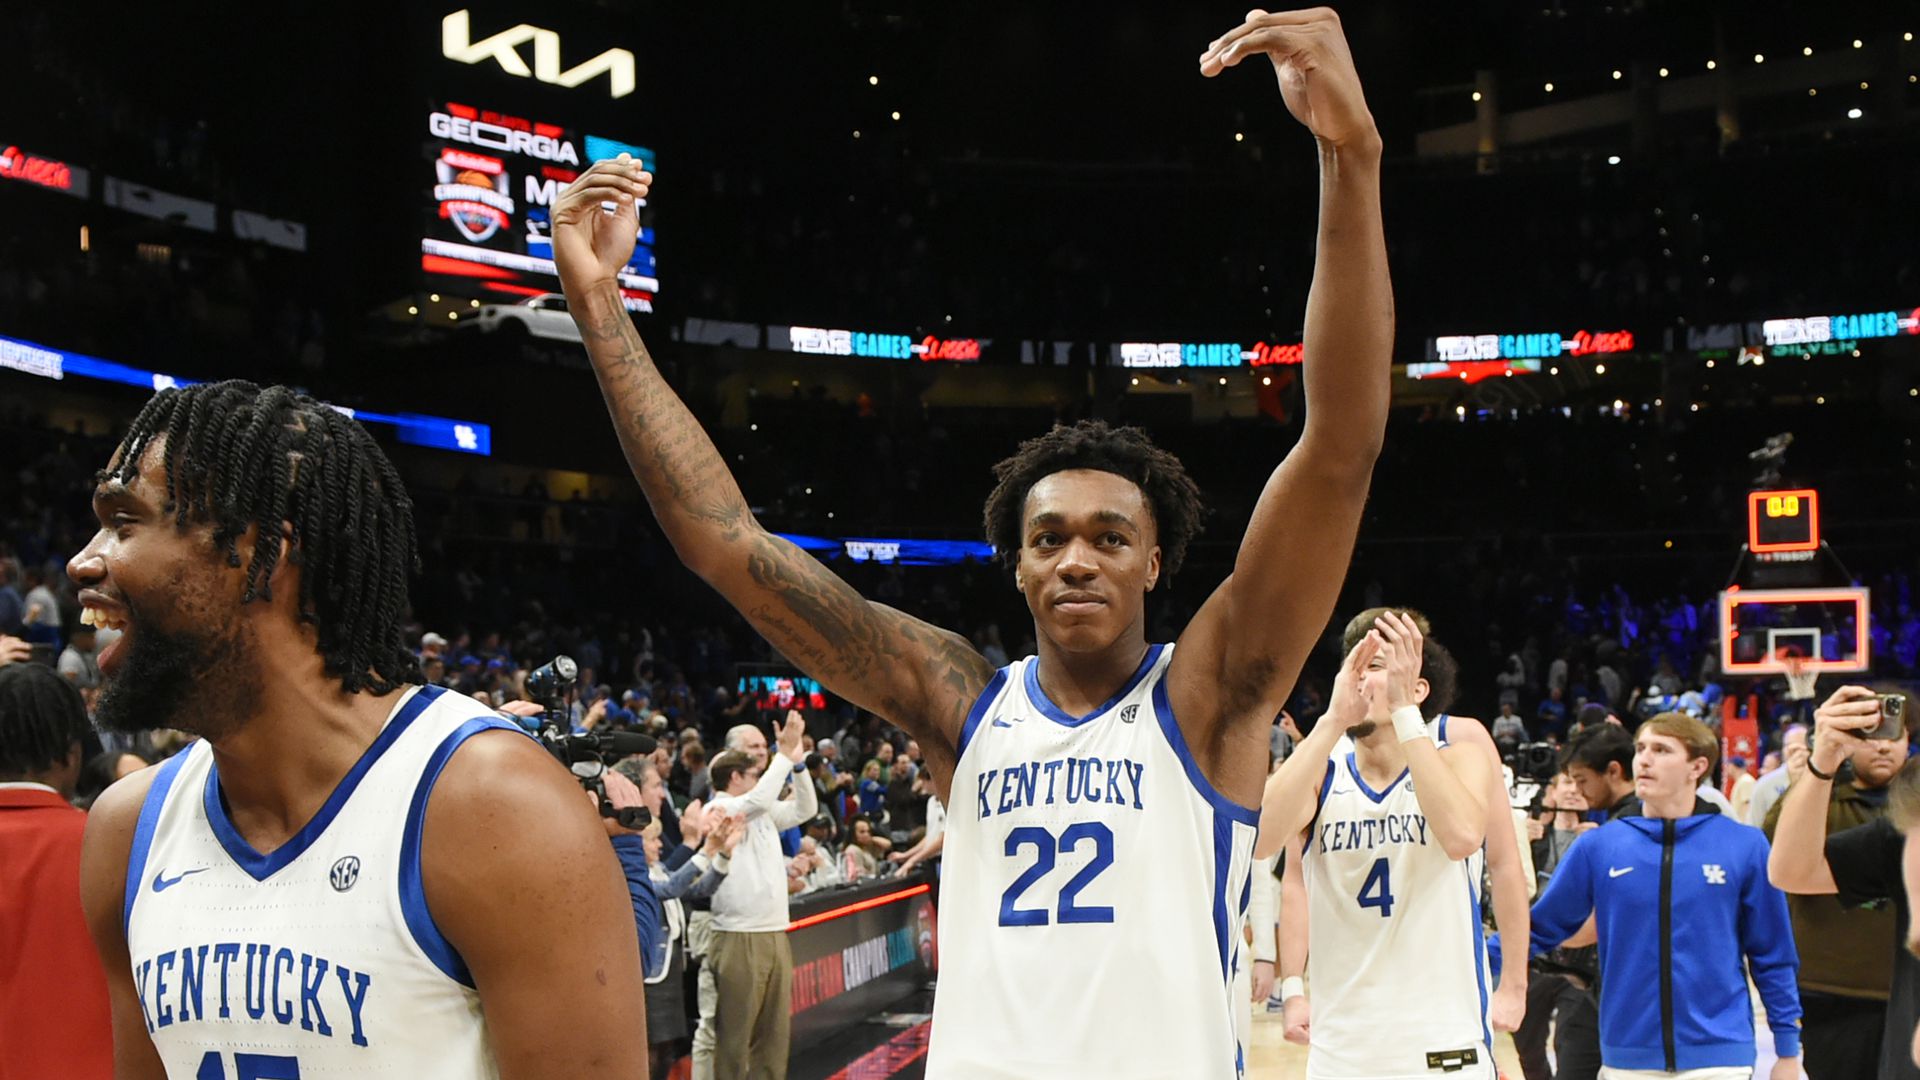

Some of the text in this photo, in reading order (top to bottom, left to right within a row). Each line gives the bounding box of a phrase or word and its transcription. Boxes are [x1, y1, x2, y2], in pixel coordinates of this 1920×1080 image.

[429, 112, 579, 166] GEORGIA
[1834, 312, 1898, 339] GAMES
[855, 332, 911, 359] GAMES
[1186, 343, 1241, 367] GAMES
[1503, 333, 1562, 358] GAMES
[978, 757, 1144, 821] KENTUCKY
[330, 856, 360, 892] SEC
[998, 821, 1115, 927] 22
[1356, 857, 1395, 918] 4
[1701, 864, 1727, 885] UK
[136, 942, 371, 1047] KENTUCKY
